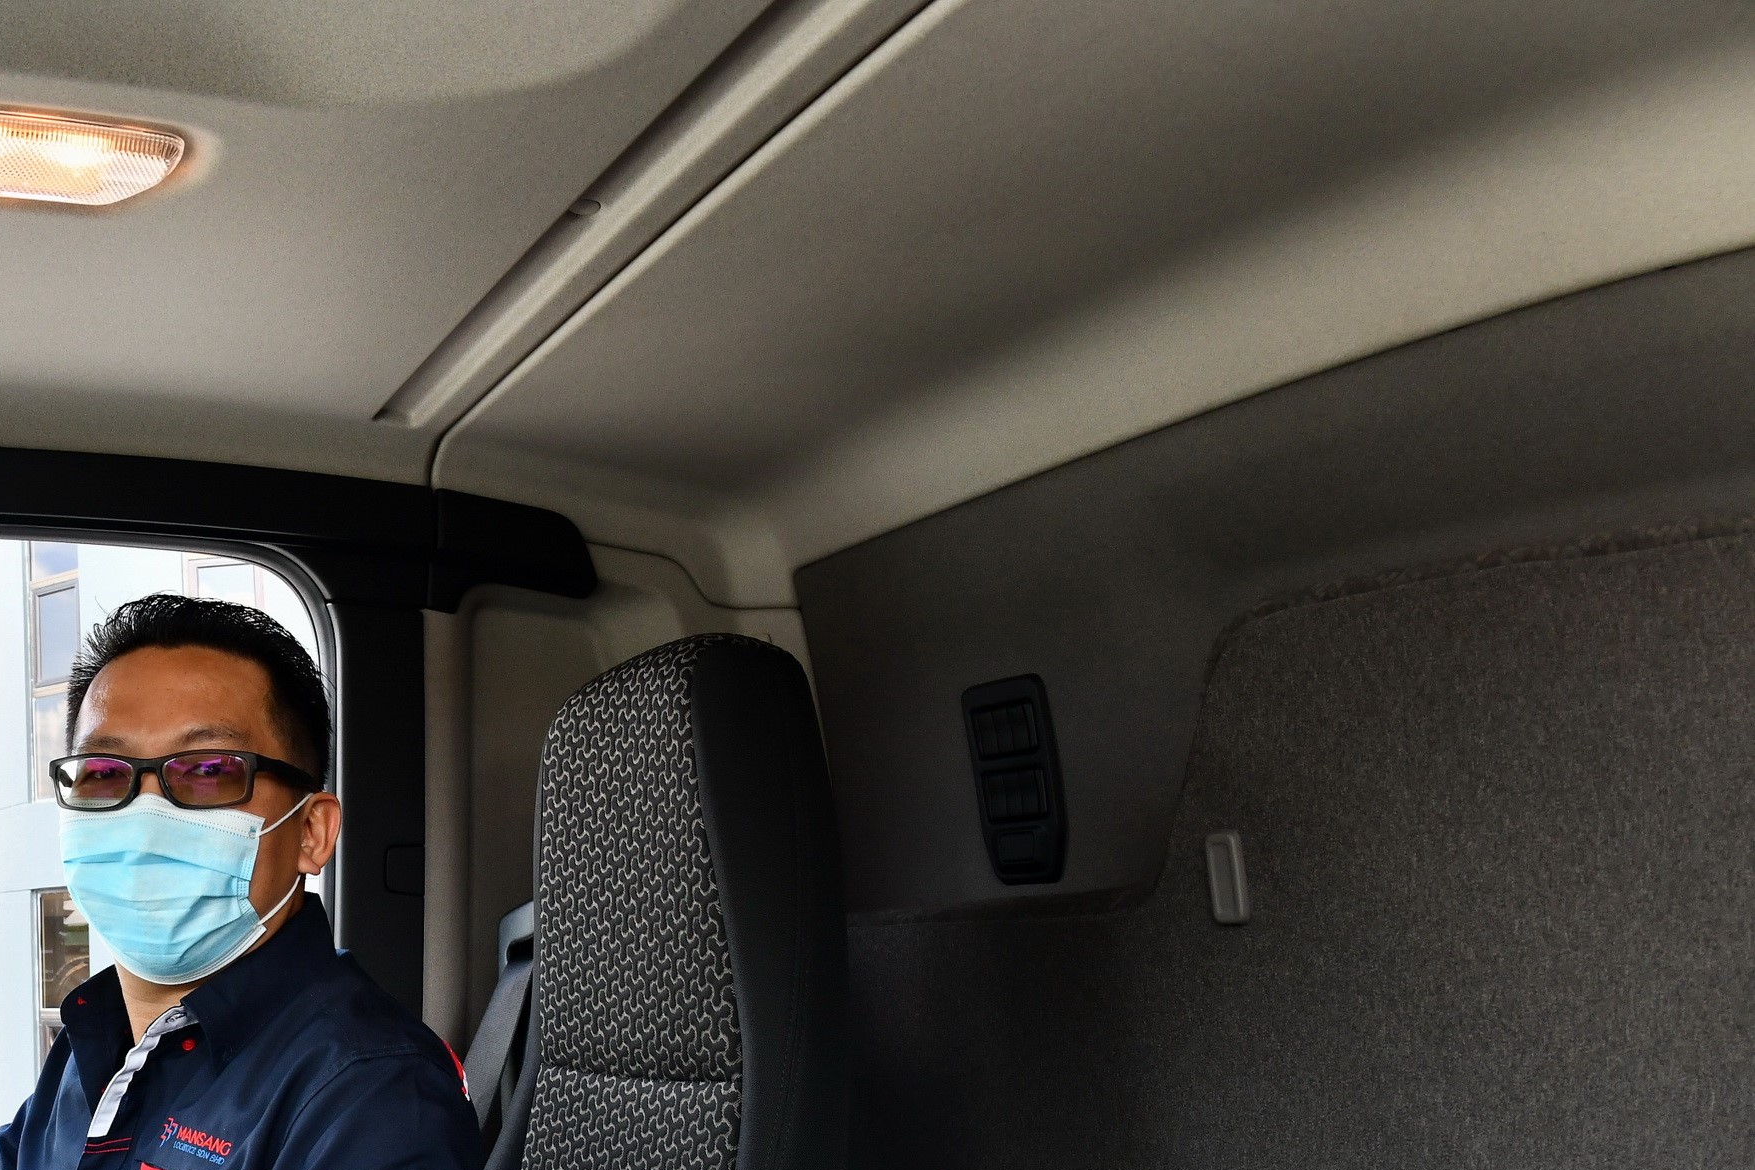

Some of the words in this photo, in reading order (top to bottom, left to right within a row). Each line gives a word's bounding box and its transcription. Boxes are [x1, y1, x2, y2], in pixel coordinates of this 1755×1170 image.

[176, 1126, 232, 1156] MANSANG
[196, 1149, 210, 1159] SDN
[209, 1154, 225, 1165] BHD
